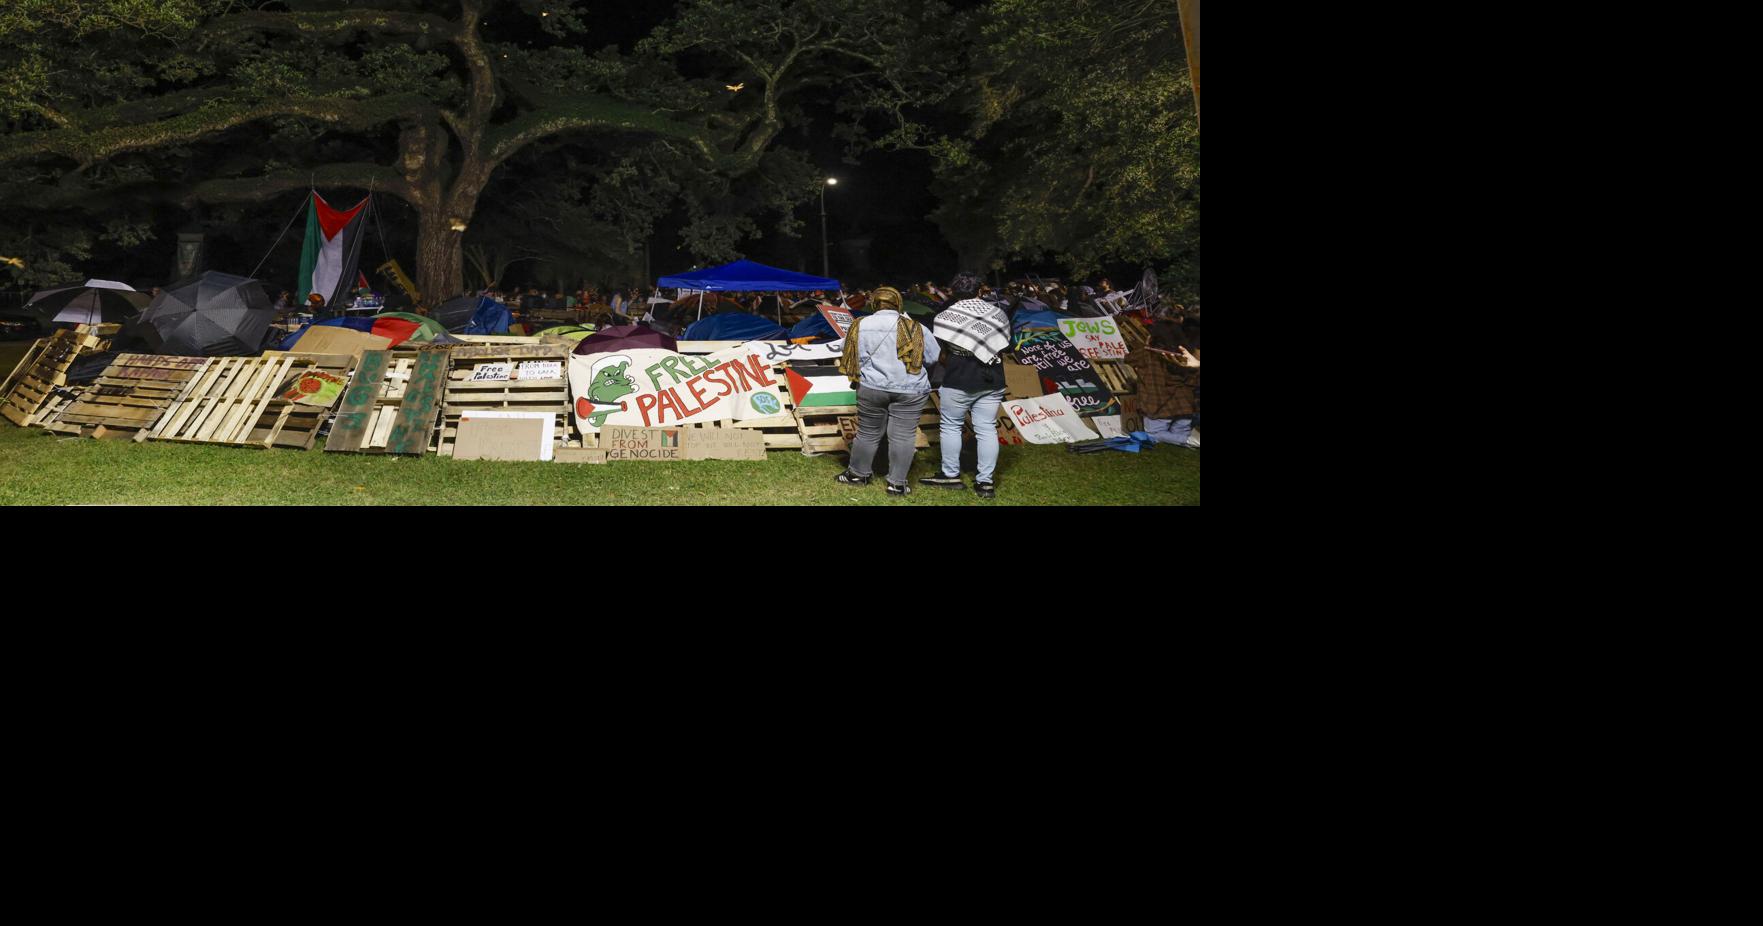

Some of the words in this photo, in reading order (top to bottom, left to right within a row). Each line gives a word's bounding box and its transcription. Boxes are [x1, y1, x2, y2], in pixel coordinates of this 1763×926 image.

[1058, 340, 1073, 349] us
[1057, 355, 1074, 367] we
[1067, 359, 1091, 372] are
[480, 365, 504, 373] Free
[644, 355, 722, 391] FREE
[473, 371, 509, 380] Palestine
[636, 353, 777, 428] PALESTINE
[612, 428, 658, 440] DIVEST
[612, 439, 649, 449] FROM
[610, 449, 678, 459] GENOCIDE
